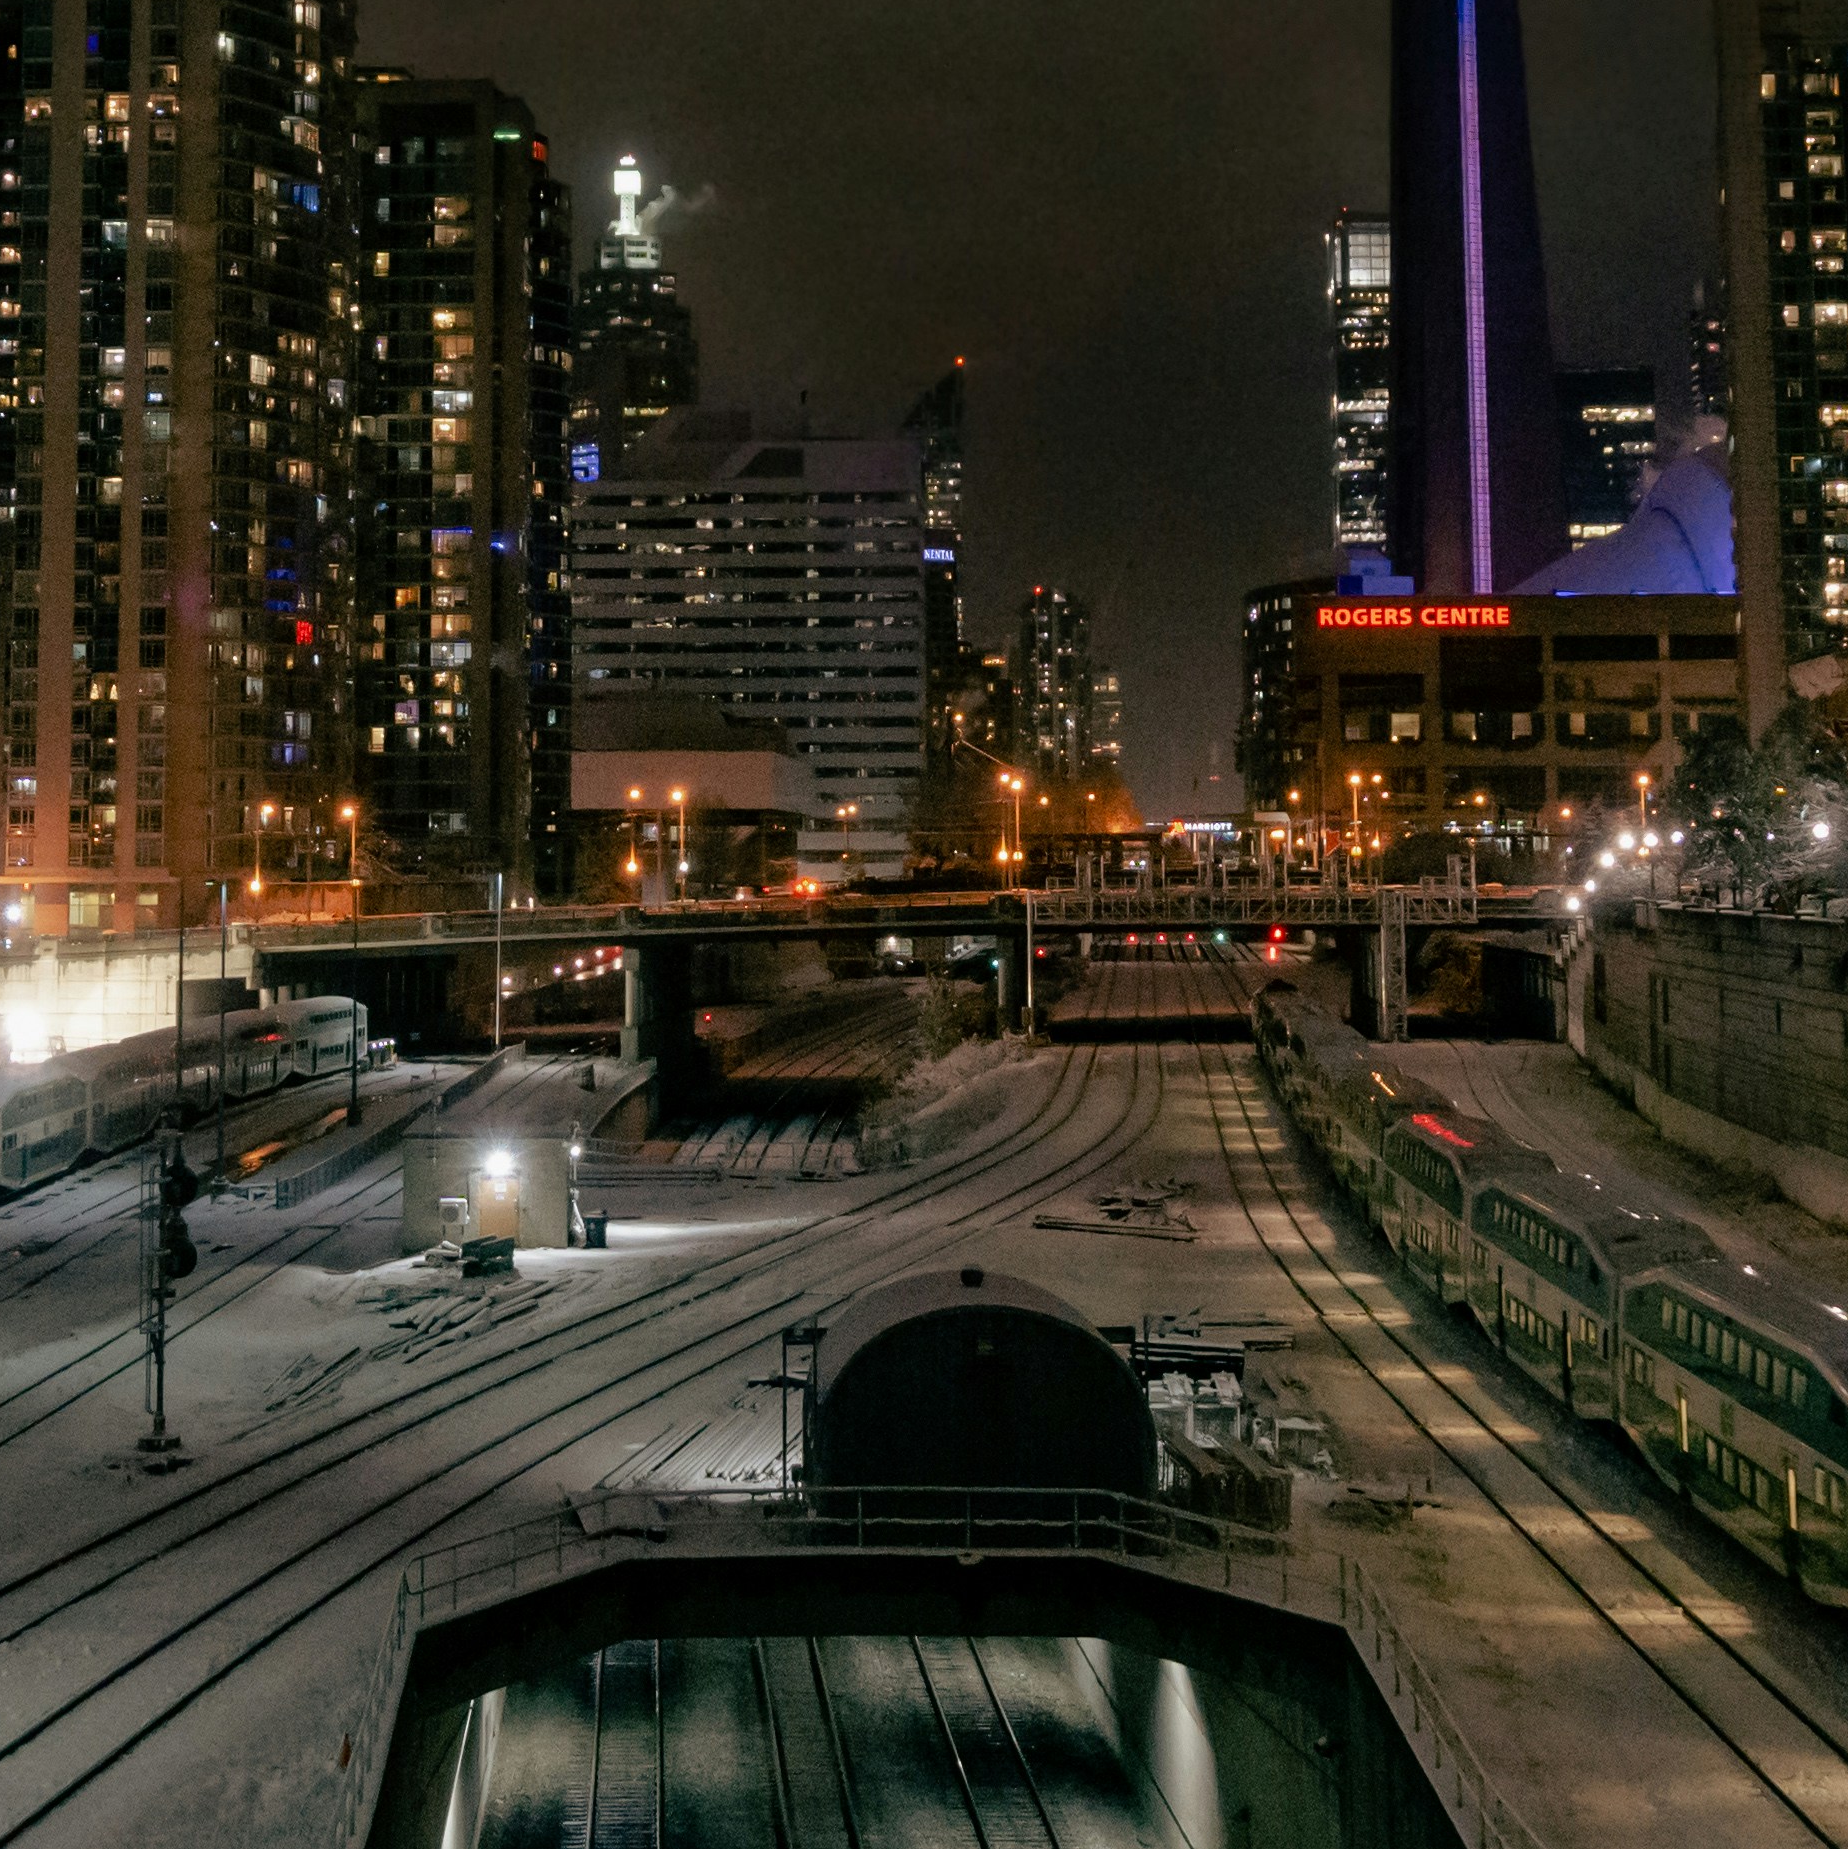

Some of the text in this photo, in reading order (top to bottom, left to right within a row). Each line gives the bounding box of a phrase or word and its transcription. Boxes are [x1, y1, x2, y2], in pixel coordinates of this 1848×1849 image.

[923, 548, 955, 562] NENTAL
[1319, 606, 1511, 627] ROGERS CENTRE
[1184, 822, 1233, 832] MARRIOTT
